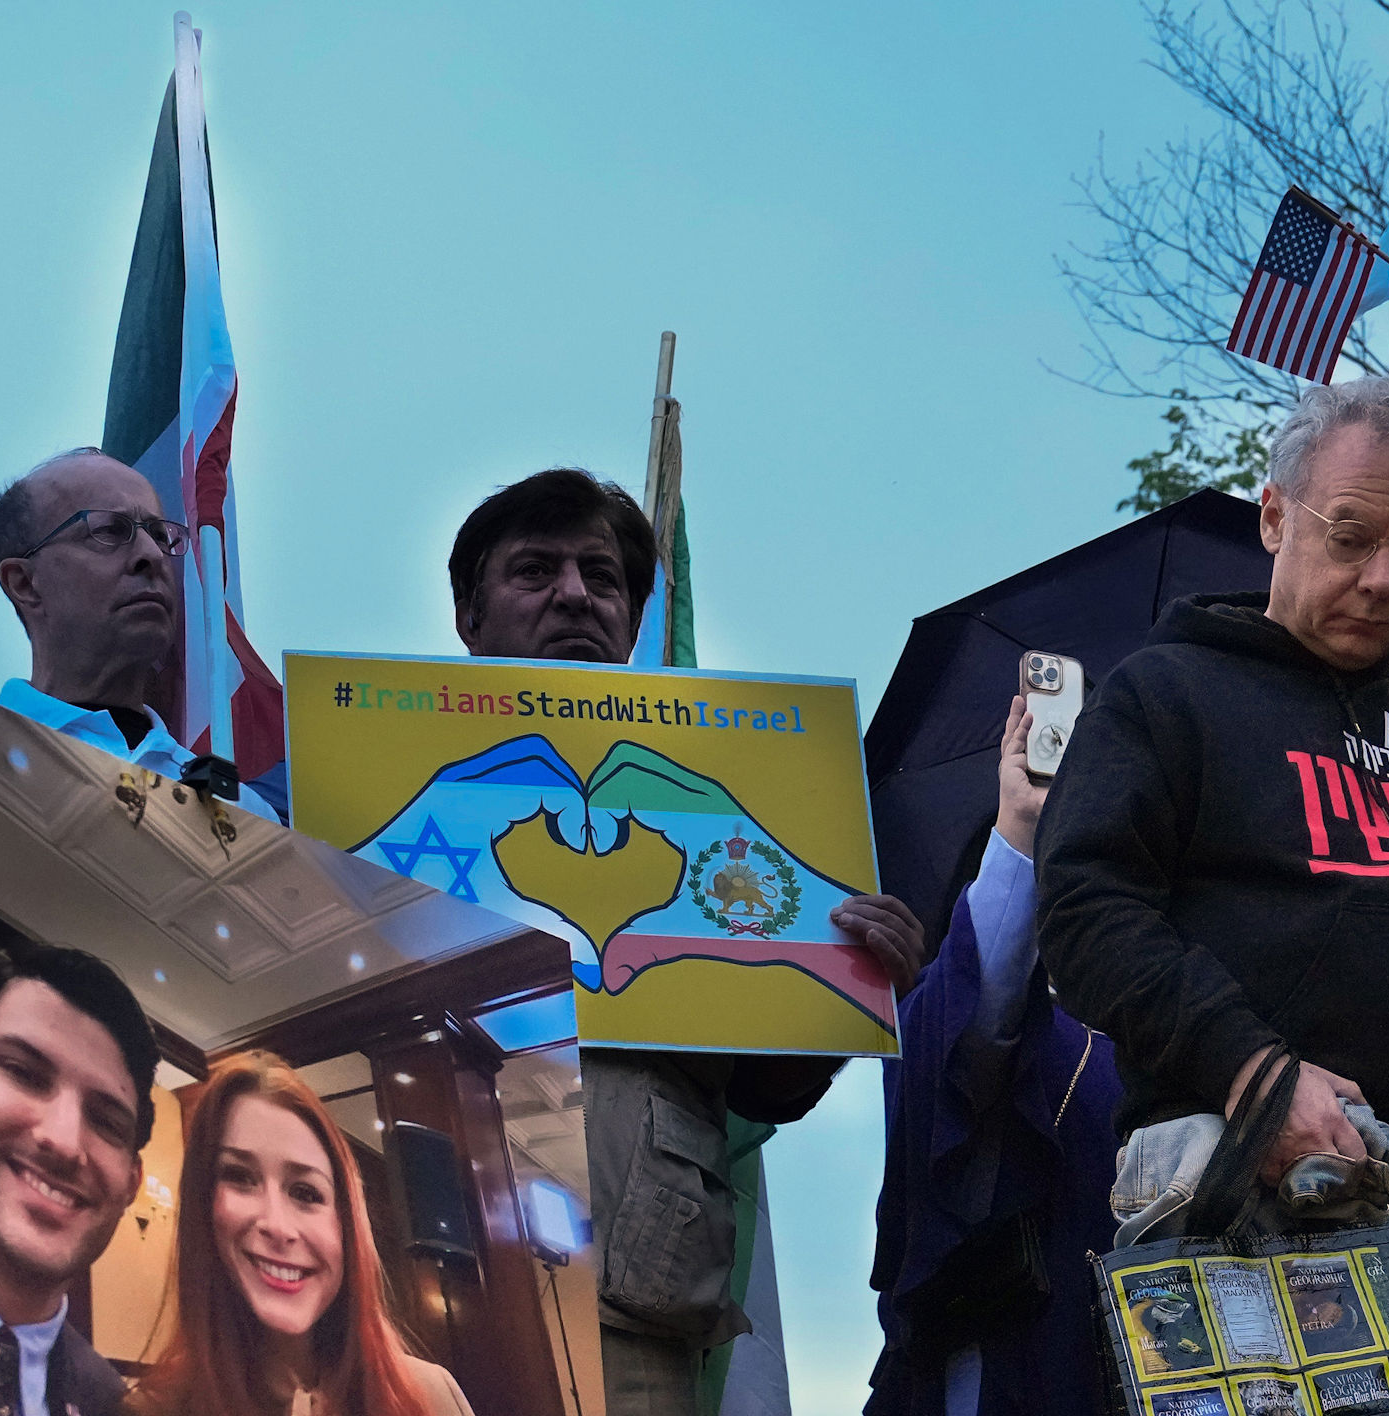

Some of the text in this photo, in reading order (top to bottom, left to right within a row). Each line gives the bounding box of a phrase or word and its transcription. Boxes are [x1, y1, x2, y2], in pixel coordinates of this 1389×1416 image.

[333, 681, 807, 734] #IraniansStandWithIsrael
[1298, 1265, 1335, 1275] NATIONAL
[1289, 1272, 1346, 1287] GEOGRAPHIC
[1326, 1369, 1376, 1386] NATIONAL
[1319, 1377, 1386, 1400] GEOGRAPHIC
[1168, 1397, 1211, 1411] NATIONAL
[1322, 1388, 1389, 1412] Bahamas Blue Holes
